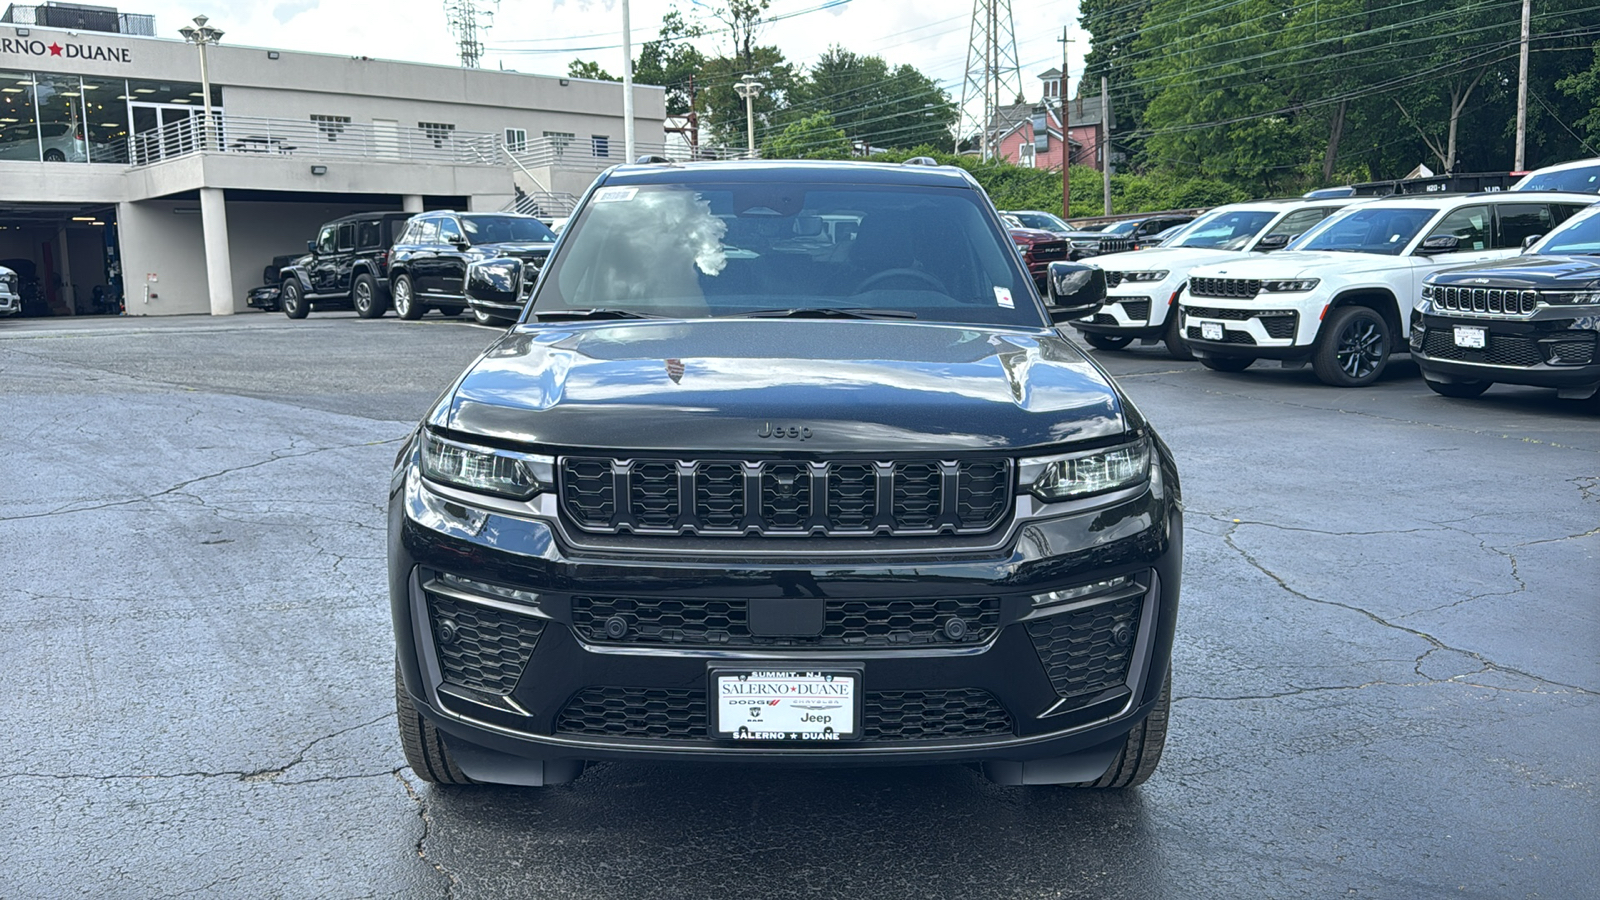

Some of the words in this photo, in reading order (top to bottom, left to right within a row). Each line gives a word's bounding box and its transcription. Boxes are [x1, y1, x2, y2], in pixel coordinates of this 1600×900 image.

[0, 38, 46, 56] RNO
[65, 43, 131, 63] DUANE
[757, 421, 813, 442] Jeep
[722, 684, 789, 695] SALERNO
[798, 684, 849, 695] DUANE
[800, 712, 832, 725] Jeep
[733, 732, 785, 740] SALERNO
[802, 732, 840, 740] DUANE
